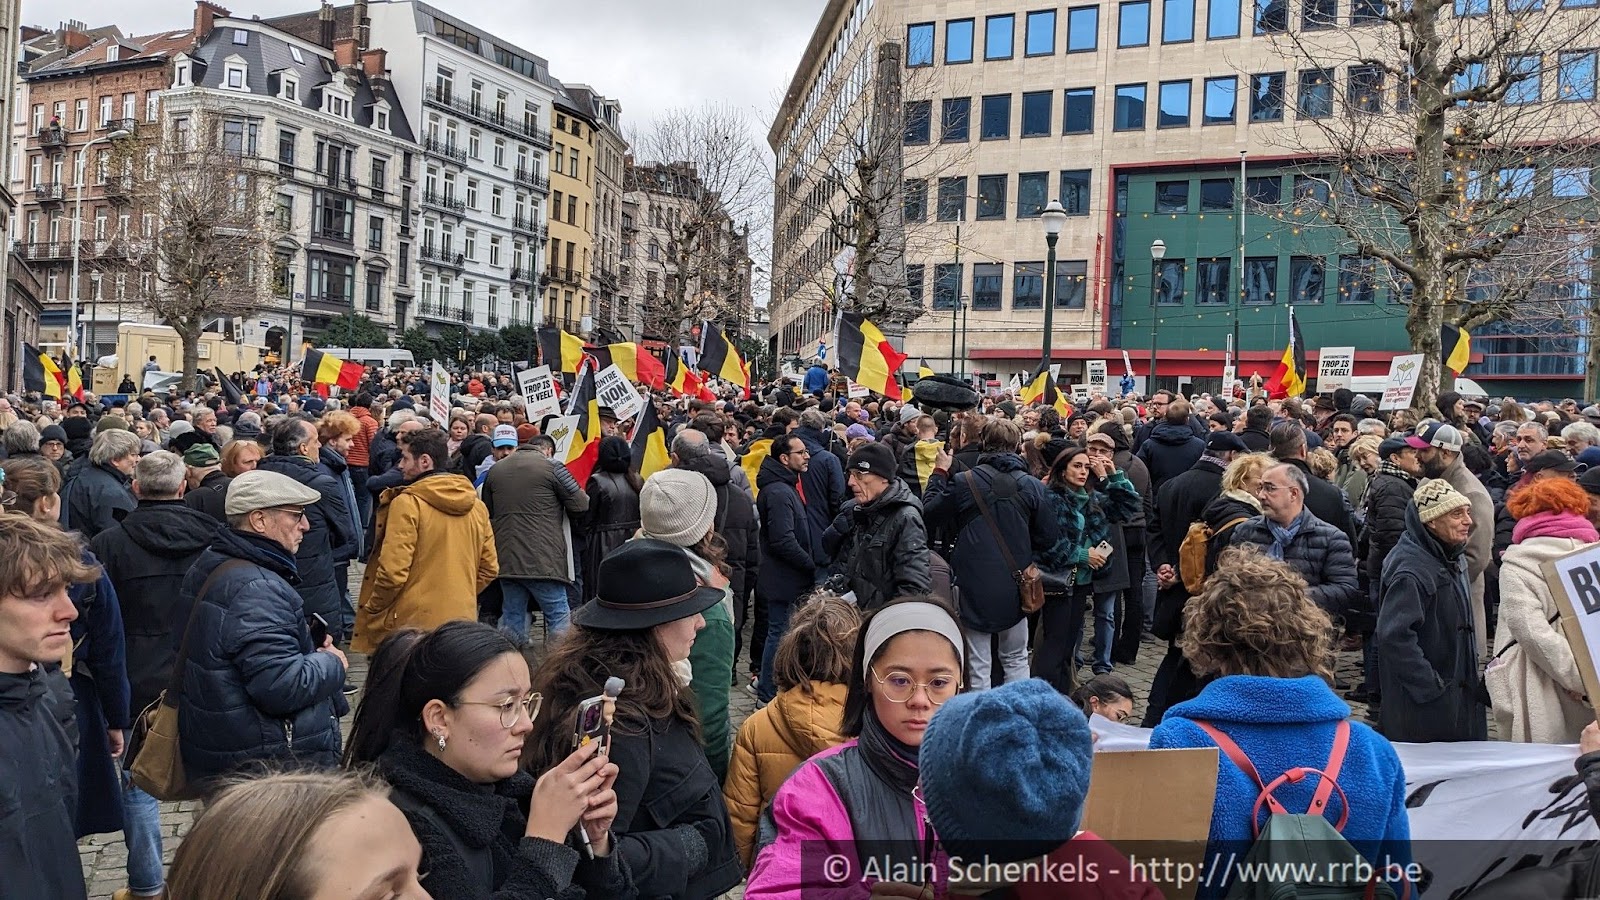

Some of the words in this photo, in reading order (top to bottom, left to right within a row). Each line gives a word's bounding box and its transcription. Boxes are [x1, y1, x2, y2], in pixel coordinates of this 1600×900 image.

[1322, 360, 1340, 368] TROP
[1341, 360, 1350, 368] IS
[524, 382, 541, 395] TROP
[542, 379, 551, 389] IS
[595, 370, 618, 388] ONTRE
[526, 394, 535, 404] TE
[535, 388, 553, 402] VEEL!
[600, 381, 629, 407] NON
